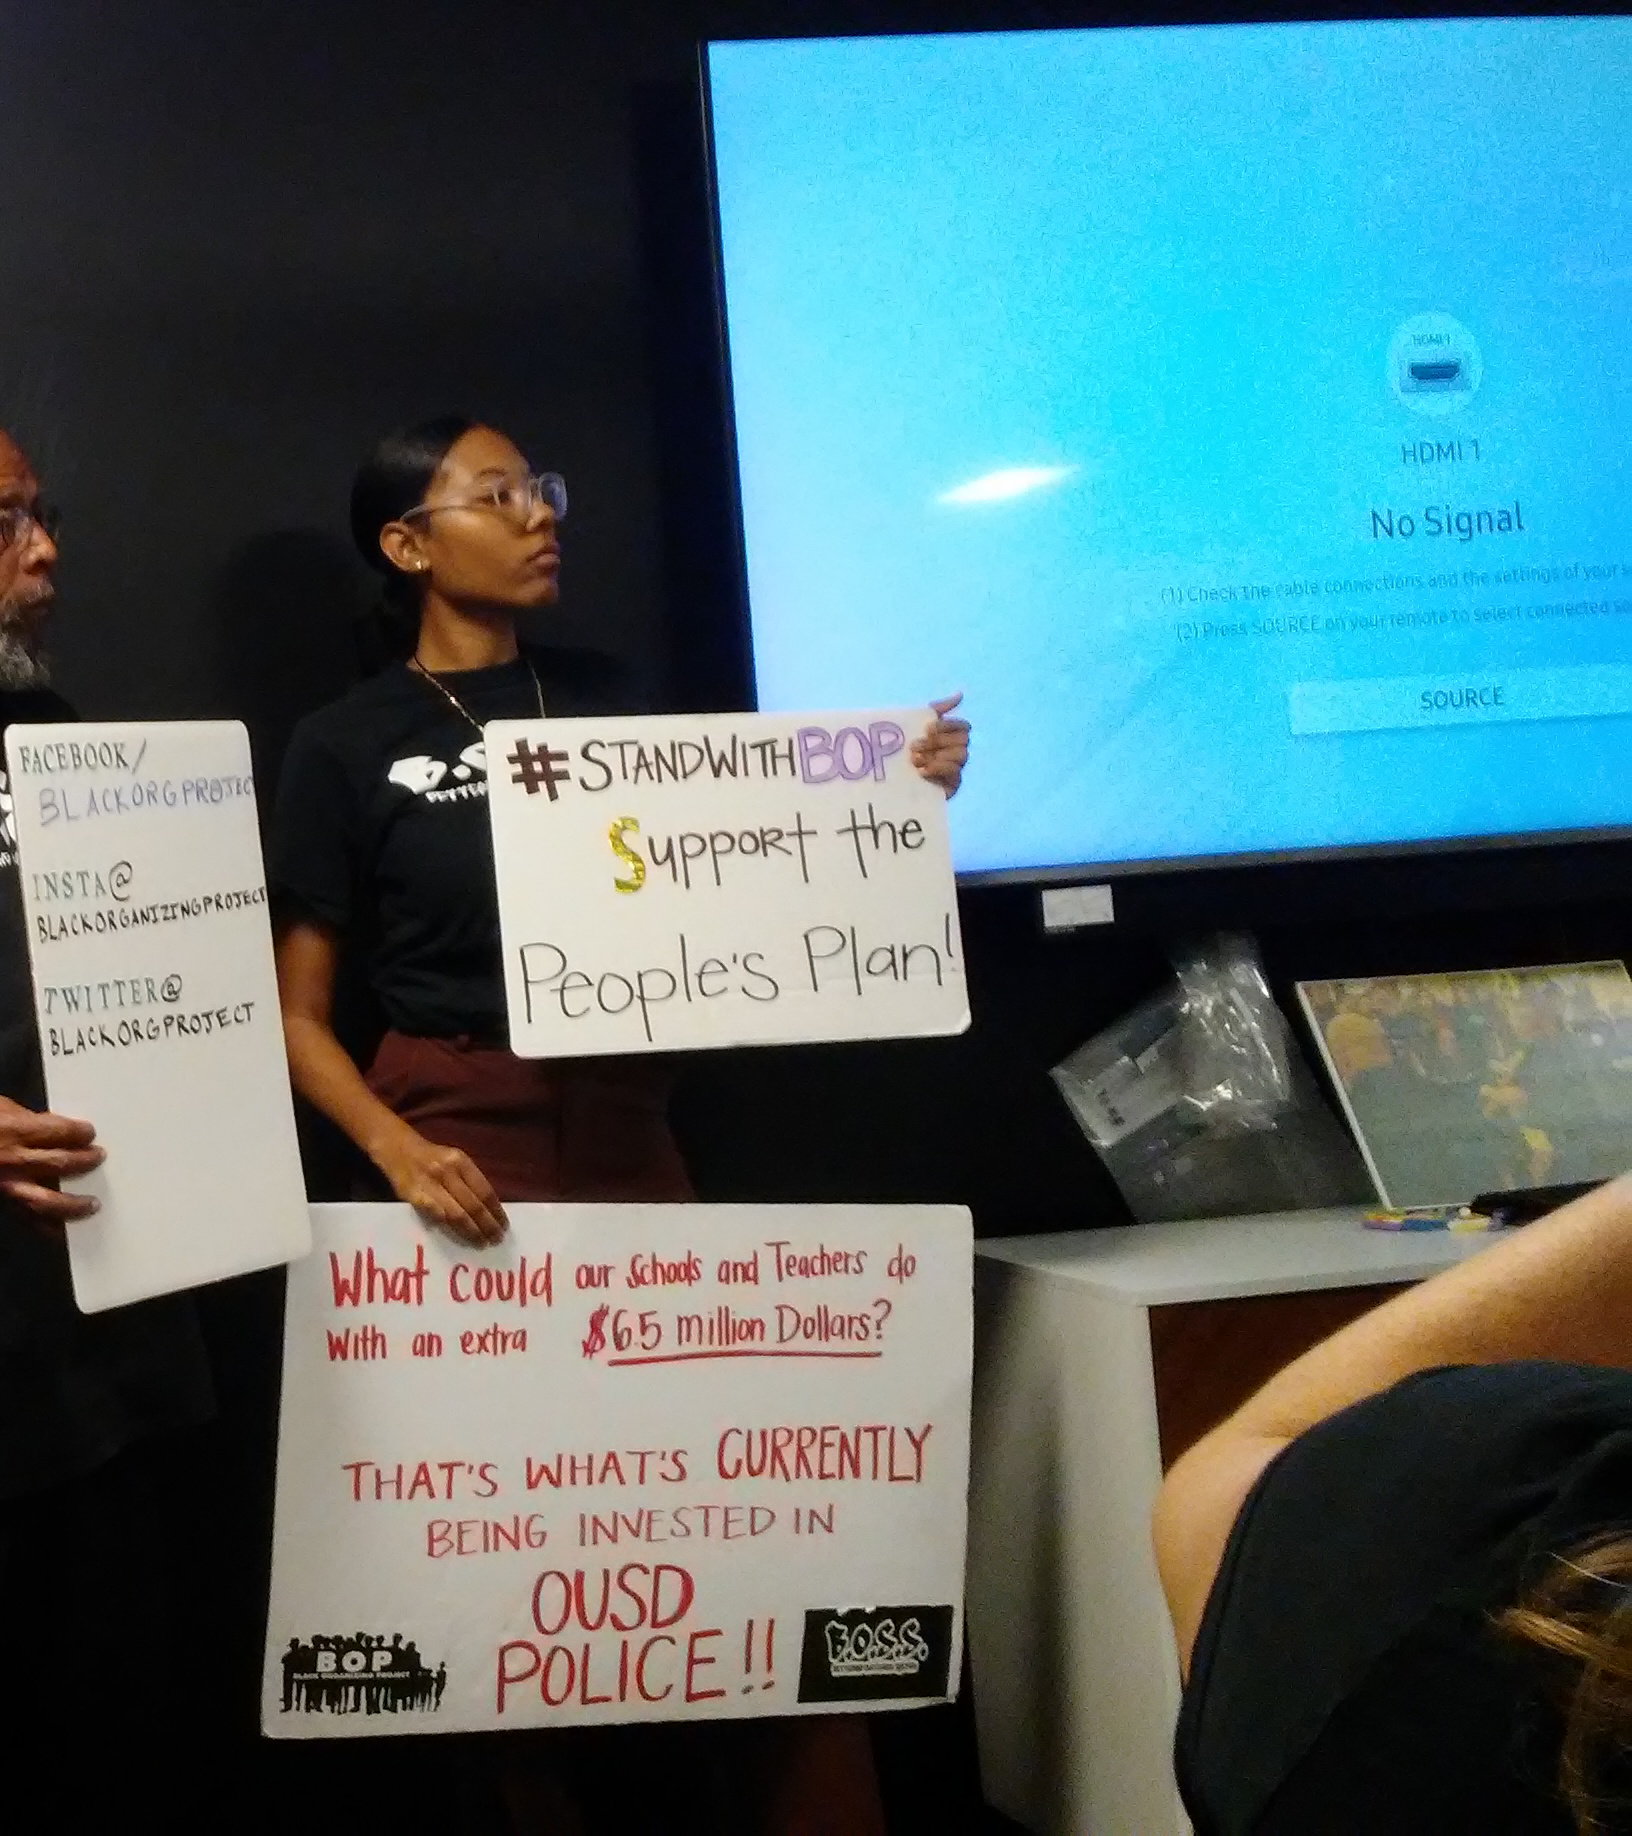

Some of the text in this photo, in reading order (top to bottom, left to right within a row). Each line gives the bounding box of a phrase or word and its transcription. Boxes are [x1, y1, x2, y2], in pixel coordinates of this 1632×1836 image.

[1402, 438, 1481, 464] HDMI 1
[1371, 500, 1526, 542] No Signal
[1187, 585, 1238, 602] Check
[1324, 573, 1423, 593] connections
[1428, 571, 1459, 590] and
[1463, 568, 1489, 587] the
[1564, 561, 1579, 580] of
[1252, 614, 1320, 636] SOURCE
[1452, 606, 1470, 623] to
[1473, 603, 1522, 621] select
[1421, 684, 1505, 710] SOURCE
[19, 738, 148, 774] FACEBOOK/
[836, 803, 926, 880] the
[32, 860, 134, 902] INSTA@
[43, 973, 184, 1016] TWITTER@
[518, 913, 960, 1043] People's Plan!
[49, 1001, 256, 1058] BLACKORGPROJECT
[329, 1244, 430, 1309] What
[575, 1263, 615, 1290] our
[717, 1249, 760, 1286] and
[763, 1240, 868, 1284] Teachers
[887, 1242, 917, 1284] do
[411, 1331, 443, 1358] an
[459, 1322, 528, 1356] extra
[676, 1305, 765, 1347] million
[774, 1298, 893, 1344] Dollars?
[341, 1424, 934, 1502] THAT'S WHAT'S CURRENTLY
[425, 1502, 835, 1558] BEING INVESTED IN
[530, 1562, 695, 1637] OUSD
[316, 1650, 394, 1673] BOP
